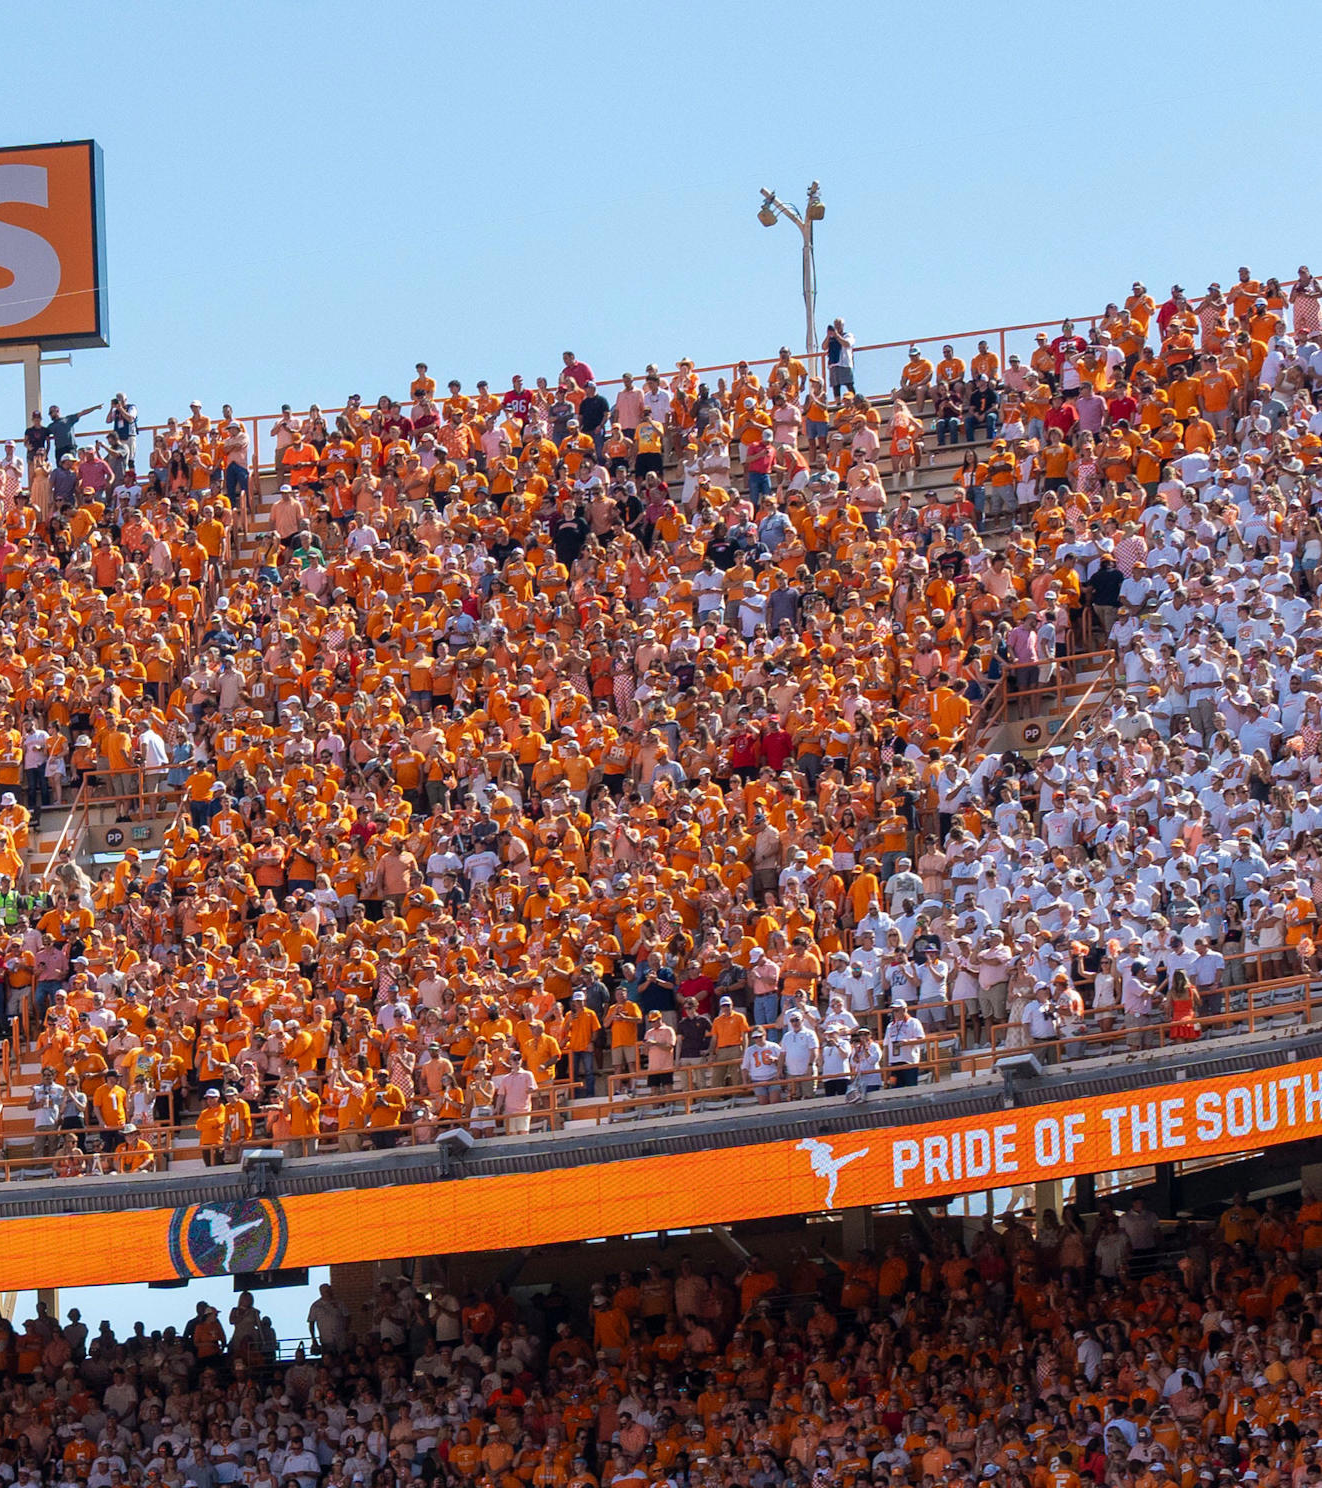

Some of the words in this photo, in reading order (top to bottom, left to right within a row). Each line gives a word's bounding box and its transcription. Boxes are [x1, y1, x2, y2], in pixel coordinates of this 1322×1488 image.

[360, 444, 372, 458] 16
[731, 666, 743, 681] 16
[932, 693, 938, 712] 1
[1024, 728, 1039, 738] PP
[222, 736, 235, 752] 16
[219, 819, 232, 835] 16
[106, 833, 121, 843] PP
[497, 927, 511, 942] T
[752, 1050, 772, 1067] 16
[892, 1124, 1018, 1188] PRIDE
[1034, 1114, 1086, 1167] OF
[1102, 1098, 1186, 1154] THE
[1195, 1073, 1322, 1141] SOUTH
[1050, 1456, 1060, 1472] 2
